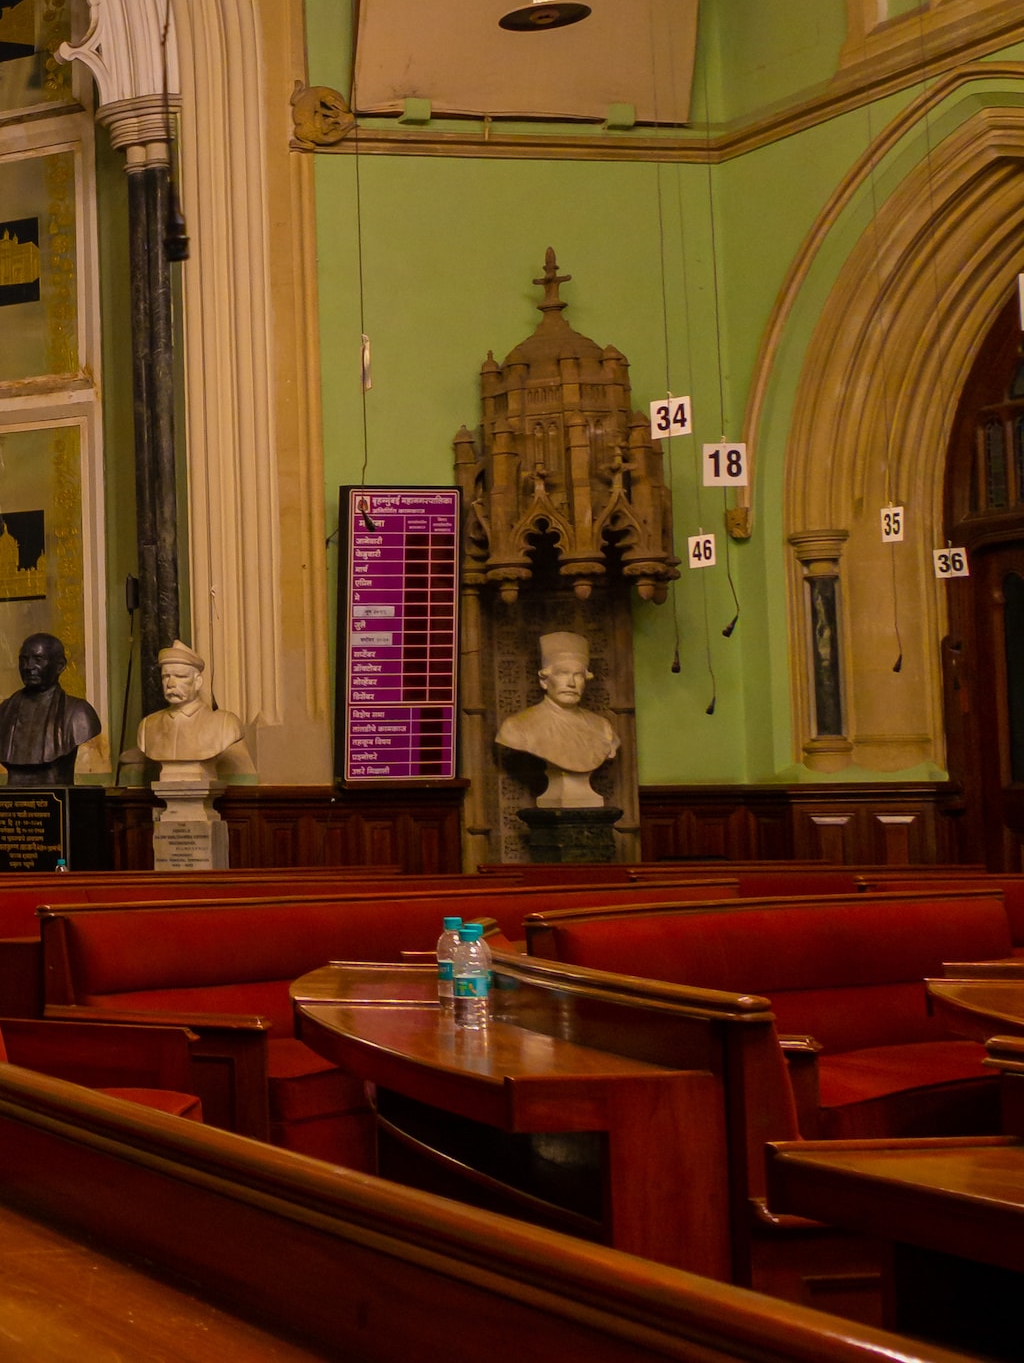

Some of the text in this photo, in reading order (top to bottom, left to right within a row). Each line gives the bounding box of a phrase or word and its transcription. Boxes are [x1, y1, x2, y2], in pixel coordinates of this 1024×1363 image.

[656, 403, 687, 431] 34
[708, 449, 742, 477] 18
[884, 512, 900, 536] 35
[692, 539, 712, 561] 46
[938, 552, 964, 573] 36
